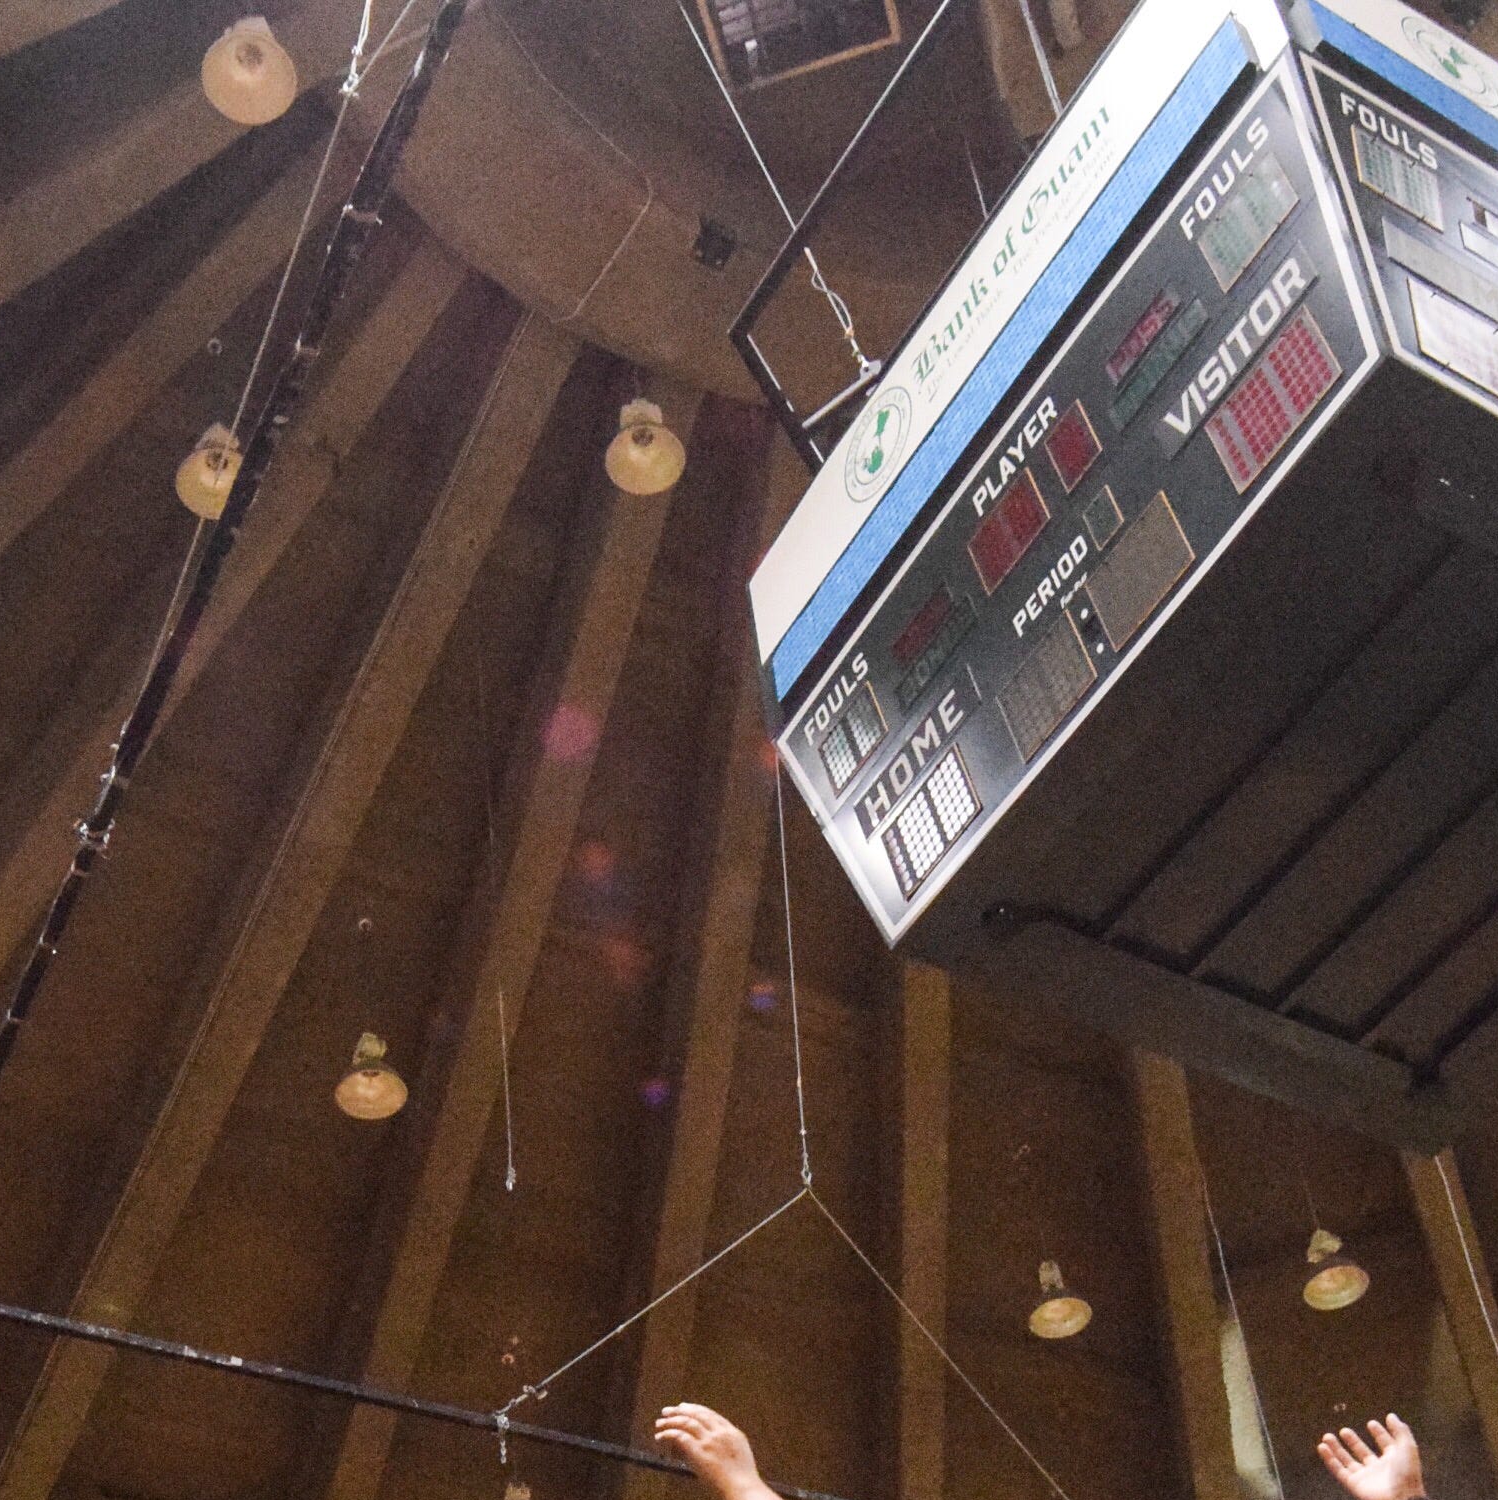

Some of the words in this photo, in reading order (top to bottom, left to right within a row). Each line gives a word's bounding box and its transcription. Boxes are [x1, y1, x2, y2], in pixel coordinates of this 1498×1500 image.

[1179, 116, 1270, 241] FOULS
[1340, 91, 1439, 170] FOULS
[910, 277, 989, 385] Bank
[992, 227, 1016, 278] of
[1021, 106, 1111, 234] Guam
[1162, 256, 1309, 435] VISITOR
[971, 396, 1058, 517] PLAYER
[1012, 535, 1089, 637] PERIOD
[803, 652, 869, 745] FOULS
[864, 689, 965, 827] HOME
